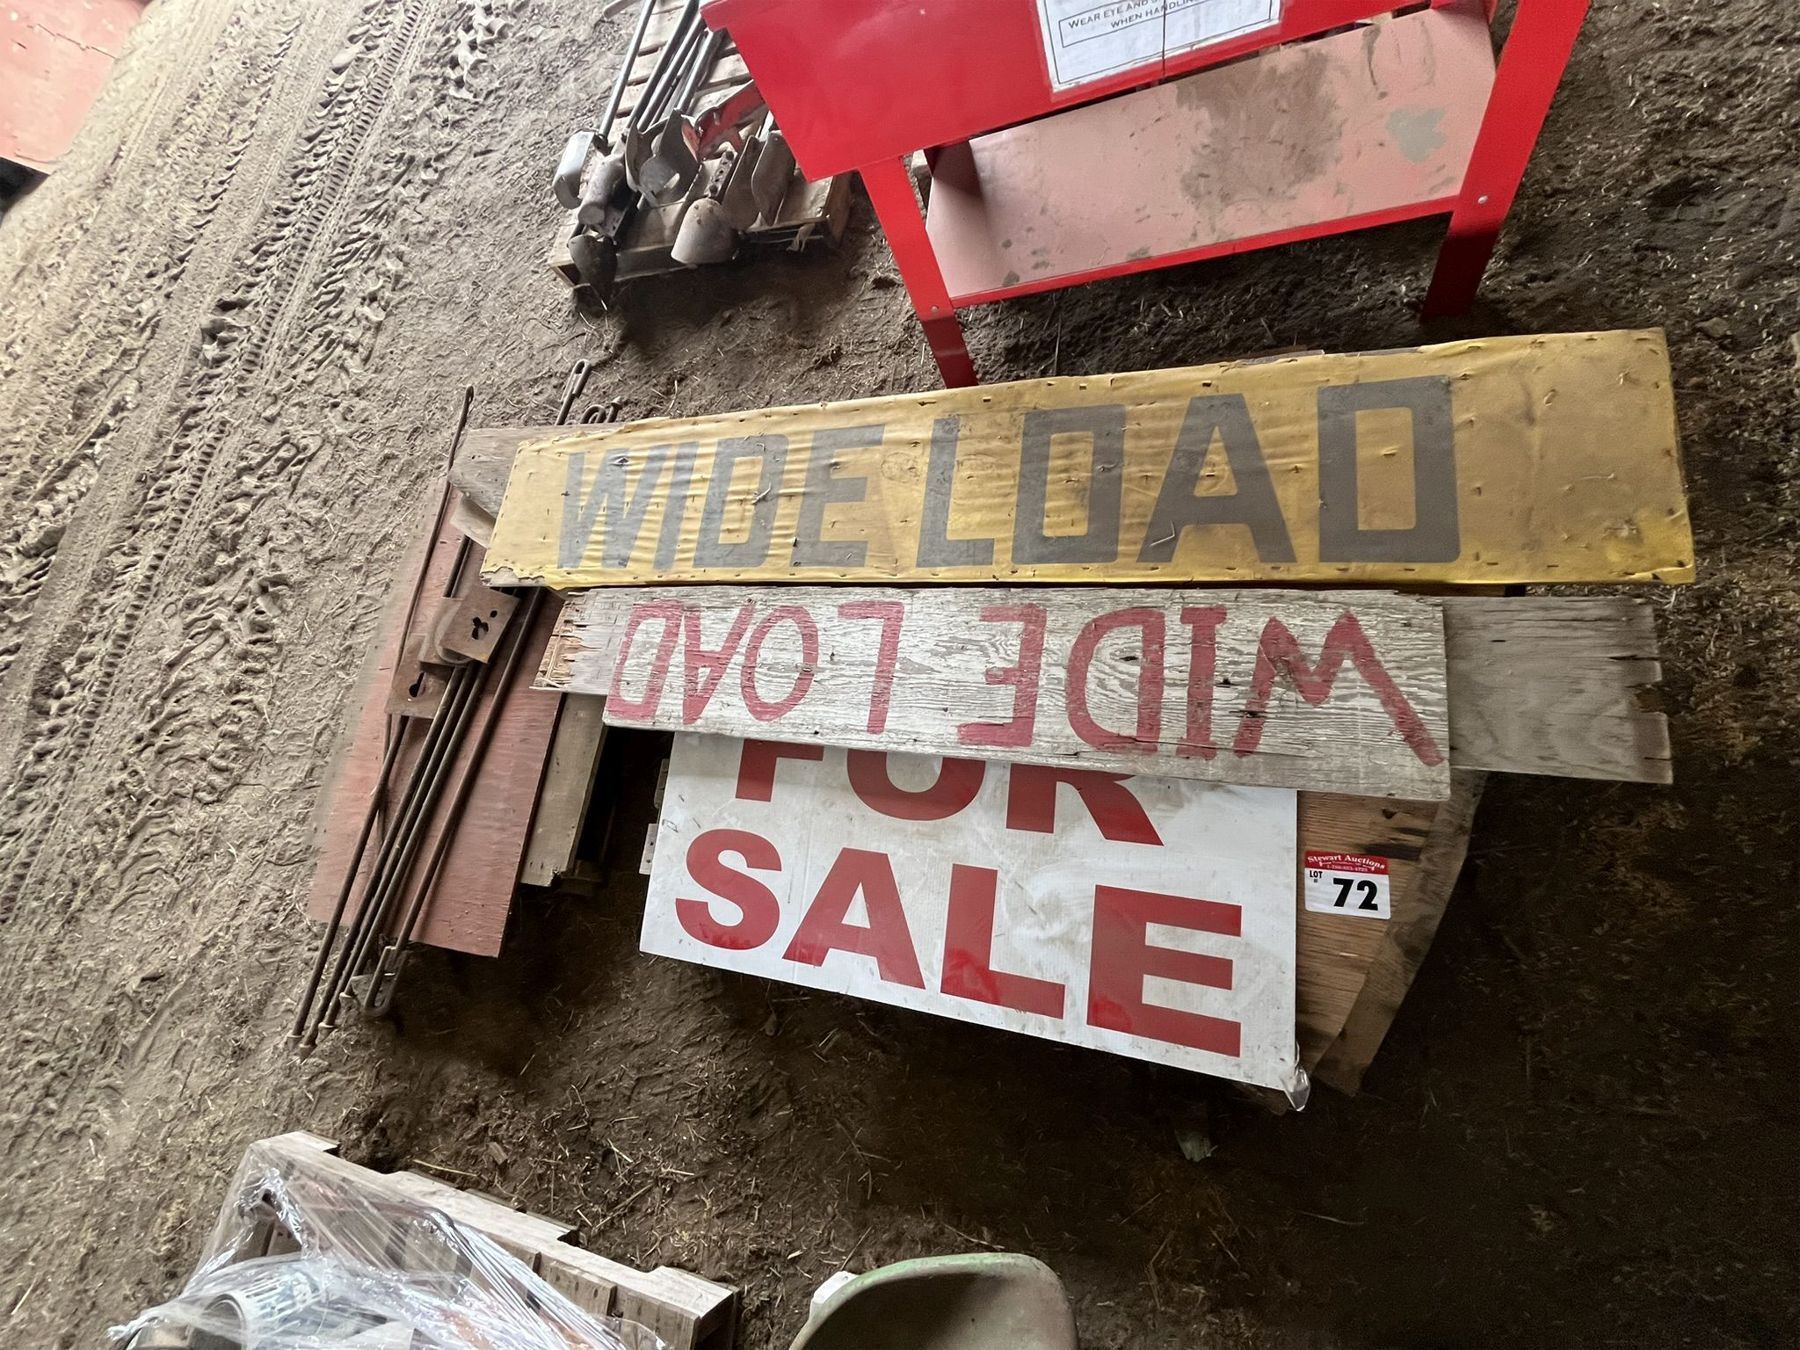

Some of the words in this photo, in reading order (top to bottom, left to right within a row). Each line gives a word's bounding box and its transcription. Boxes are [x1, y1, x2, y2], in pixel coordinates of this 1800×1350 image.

[1068, 13, 1101, 28] WEAR
[1103, 5, 1125, 18] EYE
[1110, 12, 1143, 28] WHEN
[557, 424, 885, 569] WIDE
[916, 374, 1460, 564] LOAD
[605, 599, 905, 735] LOAD
[956, 602, 1445, 768] WIDE
[1308, 855, 1341, 863] Stewart
[1345, 854, 1385, 869] Auctions
[1309, 870, 1322, 878] LOT
[1333, 877, 1378, 911] 72
[674, 827, 1242, 1058] SALE
